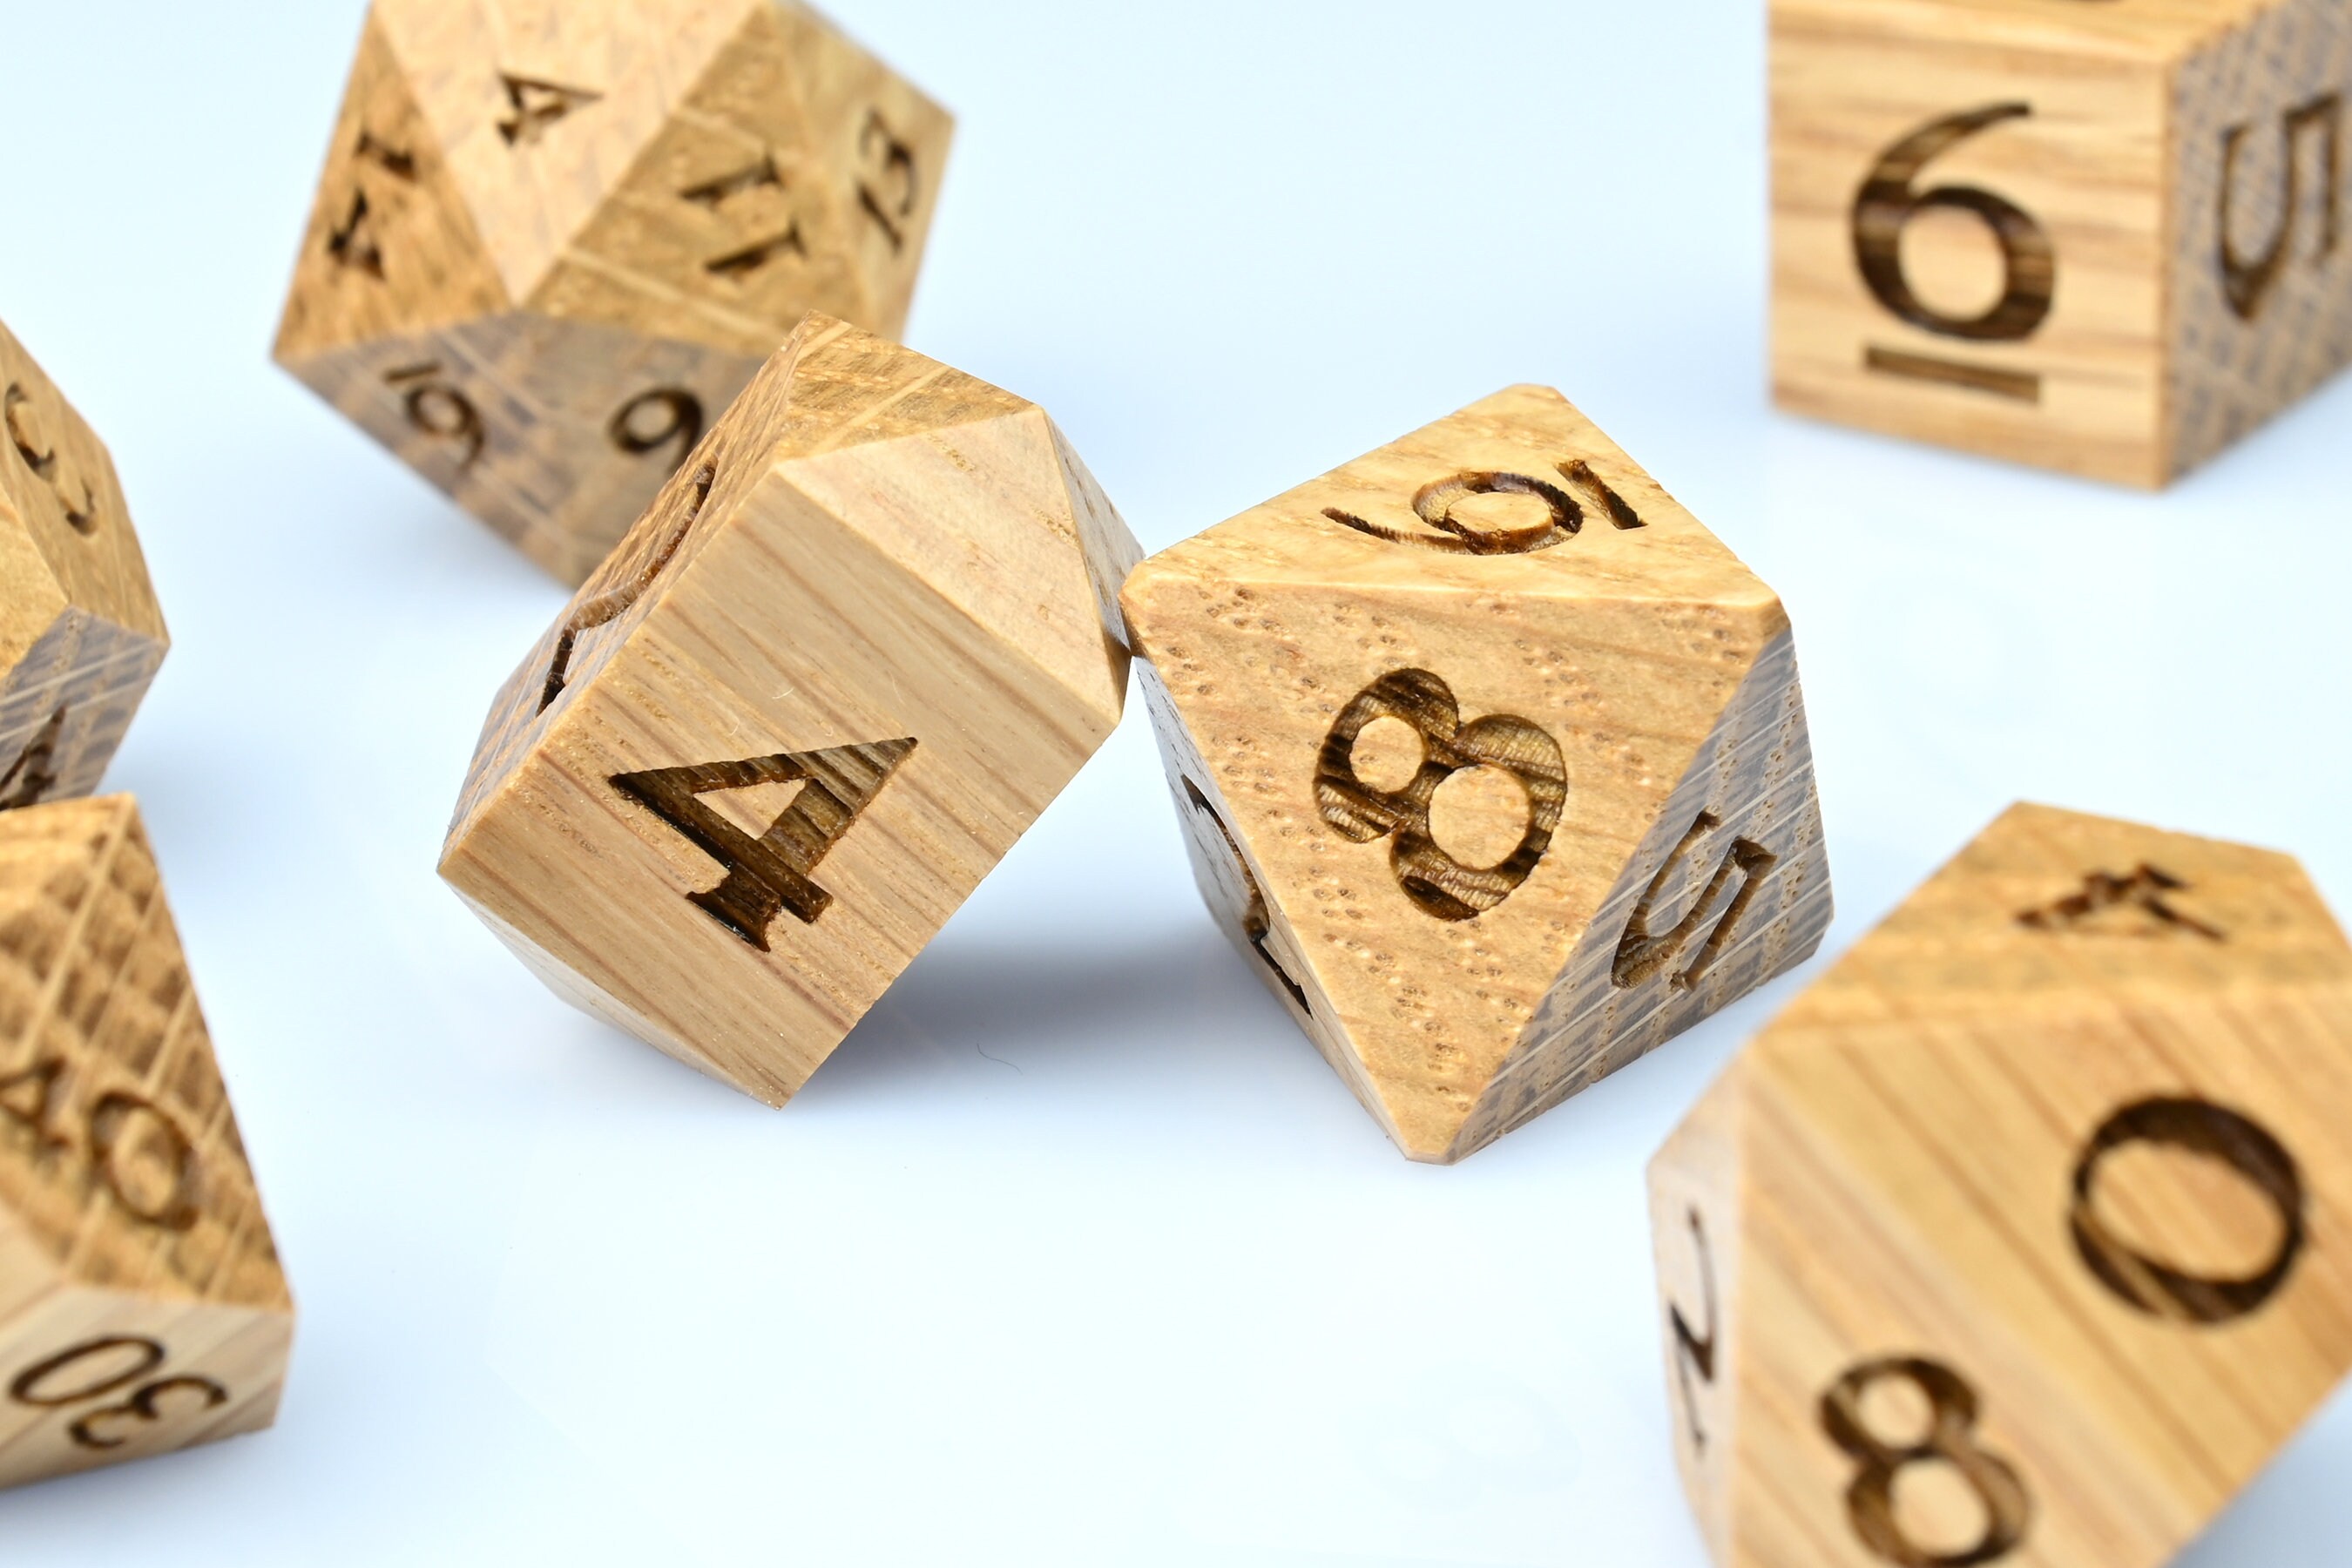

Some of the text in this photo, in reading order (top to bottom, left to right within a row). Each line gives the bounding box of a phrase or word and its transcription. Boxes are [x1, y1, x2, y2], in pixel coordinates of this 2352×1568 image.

[496, 71, 605, 146] 4
[857, 103, 919, 254] 13
[678, 145, 809, 280] 11
[1848, 99, 2056, 406] 6
[2214, 91, 2342, 325] 5
[1321, 458, 1650, 556] 6
[607, 735, 919, 953] 4
[1312, 666, 1568, 922] 8
[1612, 808, 1781, 993] 5
[9, 1333, 229, 1450] 30
[1817, 1353, 2033, 1568] 8
